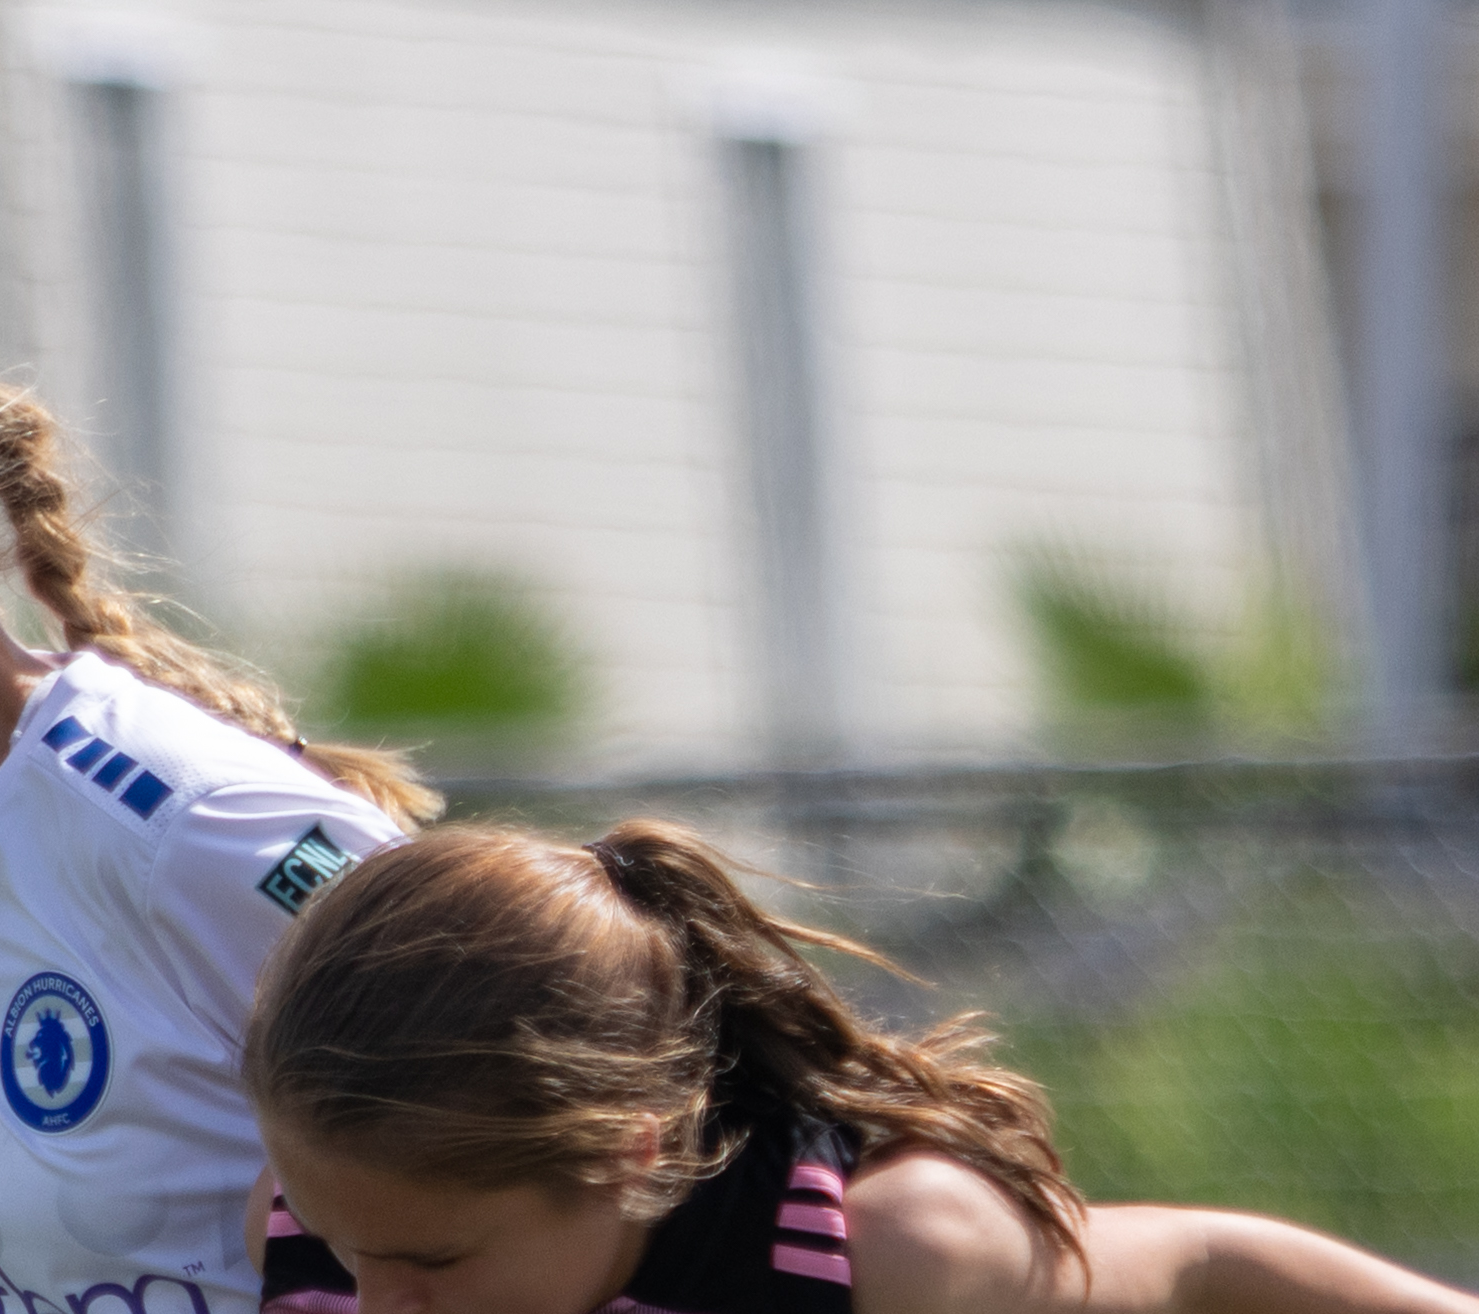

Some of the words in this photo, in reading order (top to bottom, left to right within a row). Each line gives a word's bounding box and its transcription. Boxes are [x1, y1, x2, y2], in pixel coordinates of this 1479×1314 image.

[4, 986, 33, 1039] ALBION
[33, 977, 100, 1028] HURRICANES
[42, 1113, 70, 1126] AHFC
